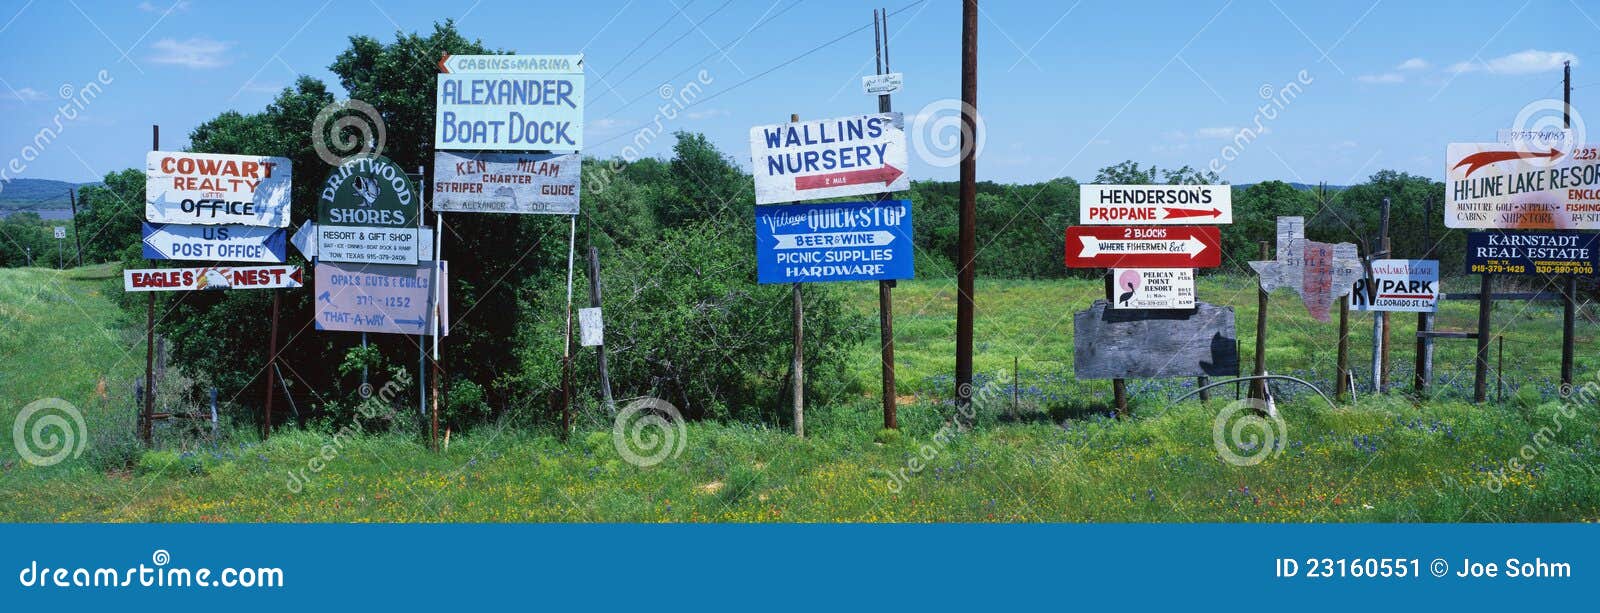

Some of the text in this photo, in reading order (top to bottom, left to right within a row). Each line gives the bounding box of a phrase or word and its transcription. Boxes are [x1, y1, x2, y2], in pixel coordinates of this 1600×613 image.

[441, 79, 577, 109] ALEXANDER
[442, 111, 576, 145] BOAT DOCK
[764, 116, 882, 149] WALLIN'S
[767, 143, 887, 176] NURSERY
[161, 156, 277, 179] COWART
[456, 158, 560, 177] KEN MILAM
[174, 177, 261, 193] REALTY
[322, 156, 412, 207] DRIFTWOOD
[482, 174, 532, 184] CHARTER
[1454, 175, 1503, 201] HI-LINE
[1508, 170, 1545, 195] LAKE
[436, 182, 576, 196] STRIPER GUIDE
[1100, 186, 1212, 204] HENDERSON'S
[180, 198, 254, 217] OFFICE
[1089, 207, 1157, 221] PROPANE
[1496, 203, 1513, 211] GOLF
[330, 208, 405, 224] SHORES
[762, 209, 807, 233] Village
[1457, 212, 1487, 221] CABINS
[202, 227, 231, 241] U.S.
[323, 231, 412, 241] RESORT & GIFT SHOP
[1124, 228, 1167, 238] 2 BLOCKS
[1099, 241, 1186, 252] WHERE FISHERMEN Eat
[1488, 235, 1579, 247] KARNSTADT
[172, 243, 261, 258] POST OFFICE
[346, 252, 365, 260] TEXAS
[777, 249, 893, 264] PICNIC SUPPLIES
[1476, 247, 1589, 259] REAL ESTATE
[234, 269, 286, 285] NEST
[786, 264, 885, 277] HARDWARE
[366, 276, 389, 287] CUTS
[400, 277, 428, 289] CURLS
[1352, 277, 1433, 306] RV PARK
